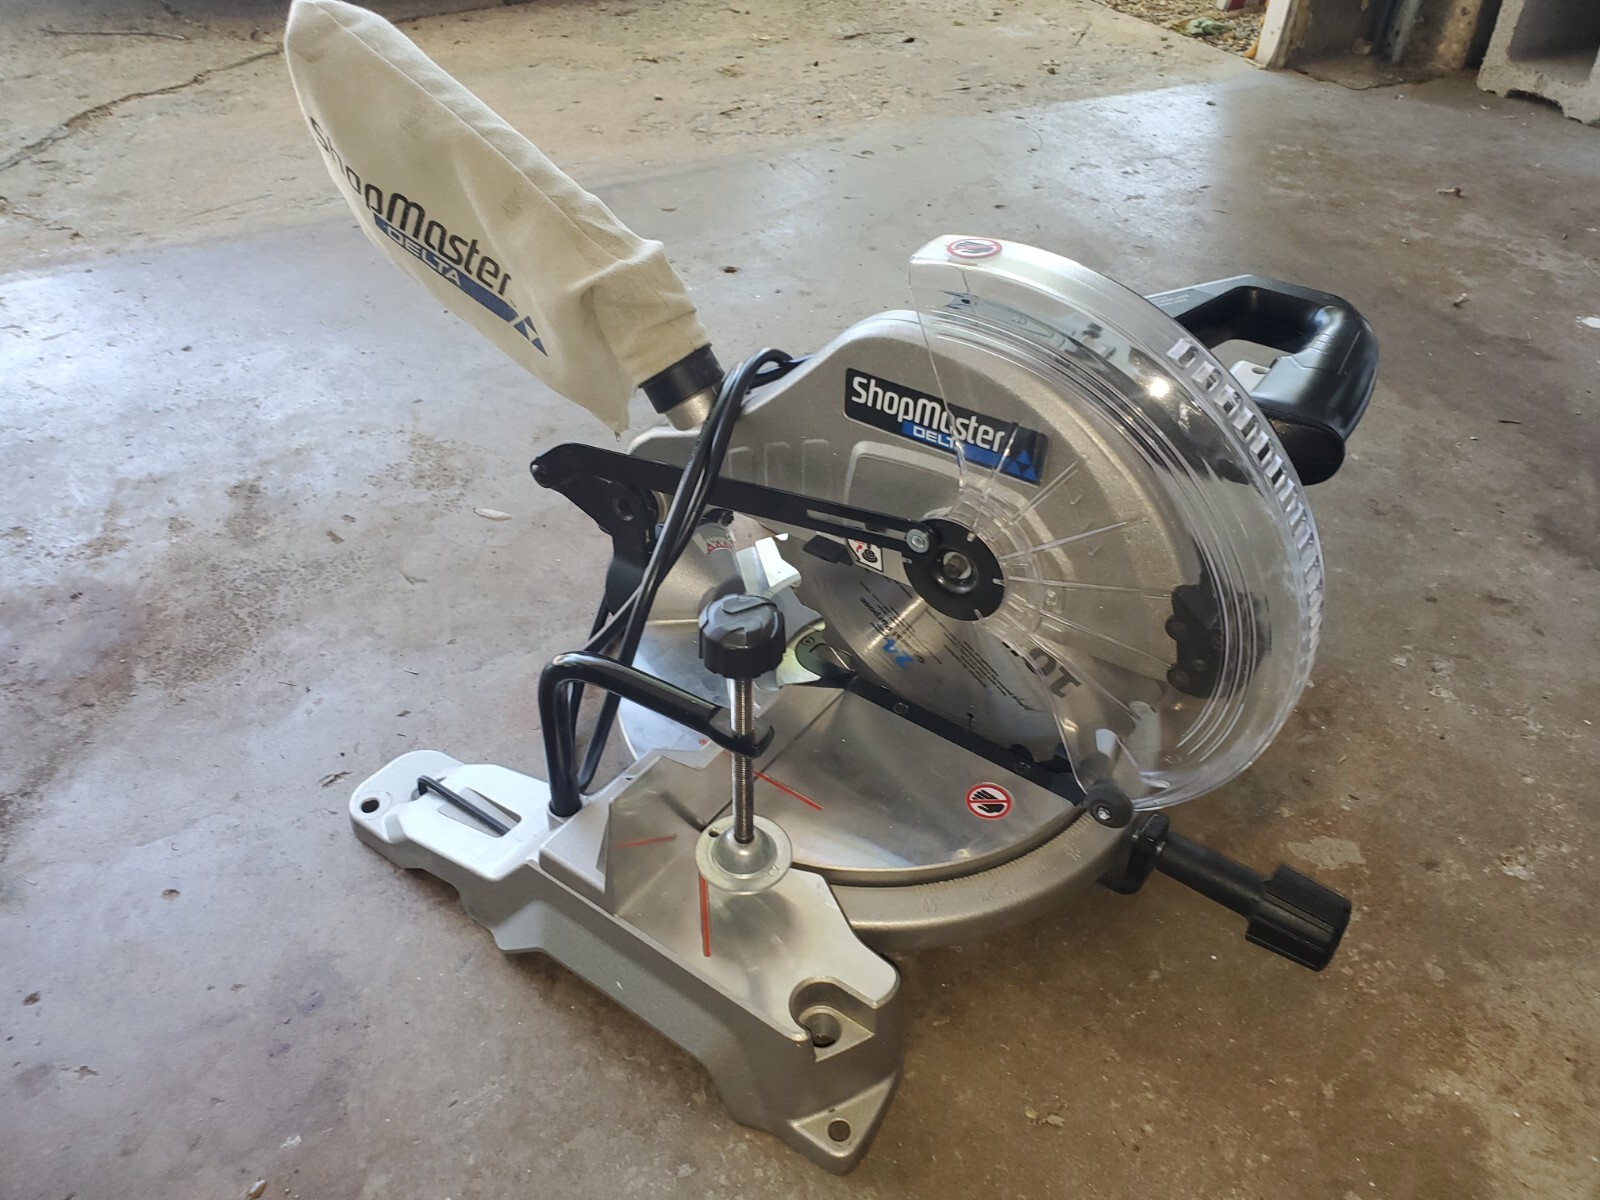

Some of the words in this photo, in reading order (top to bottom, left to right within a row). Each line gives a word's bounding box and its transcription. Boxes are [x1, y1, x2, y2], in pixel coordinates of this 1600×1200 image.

[386, 226, 462, 287] DELTA
[912, 425, 960, 450] DELT
[860, 597, 893, 631] Purpose
